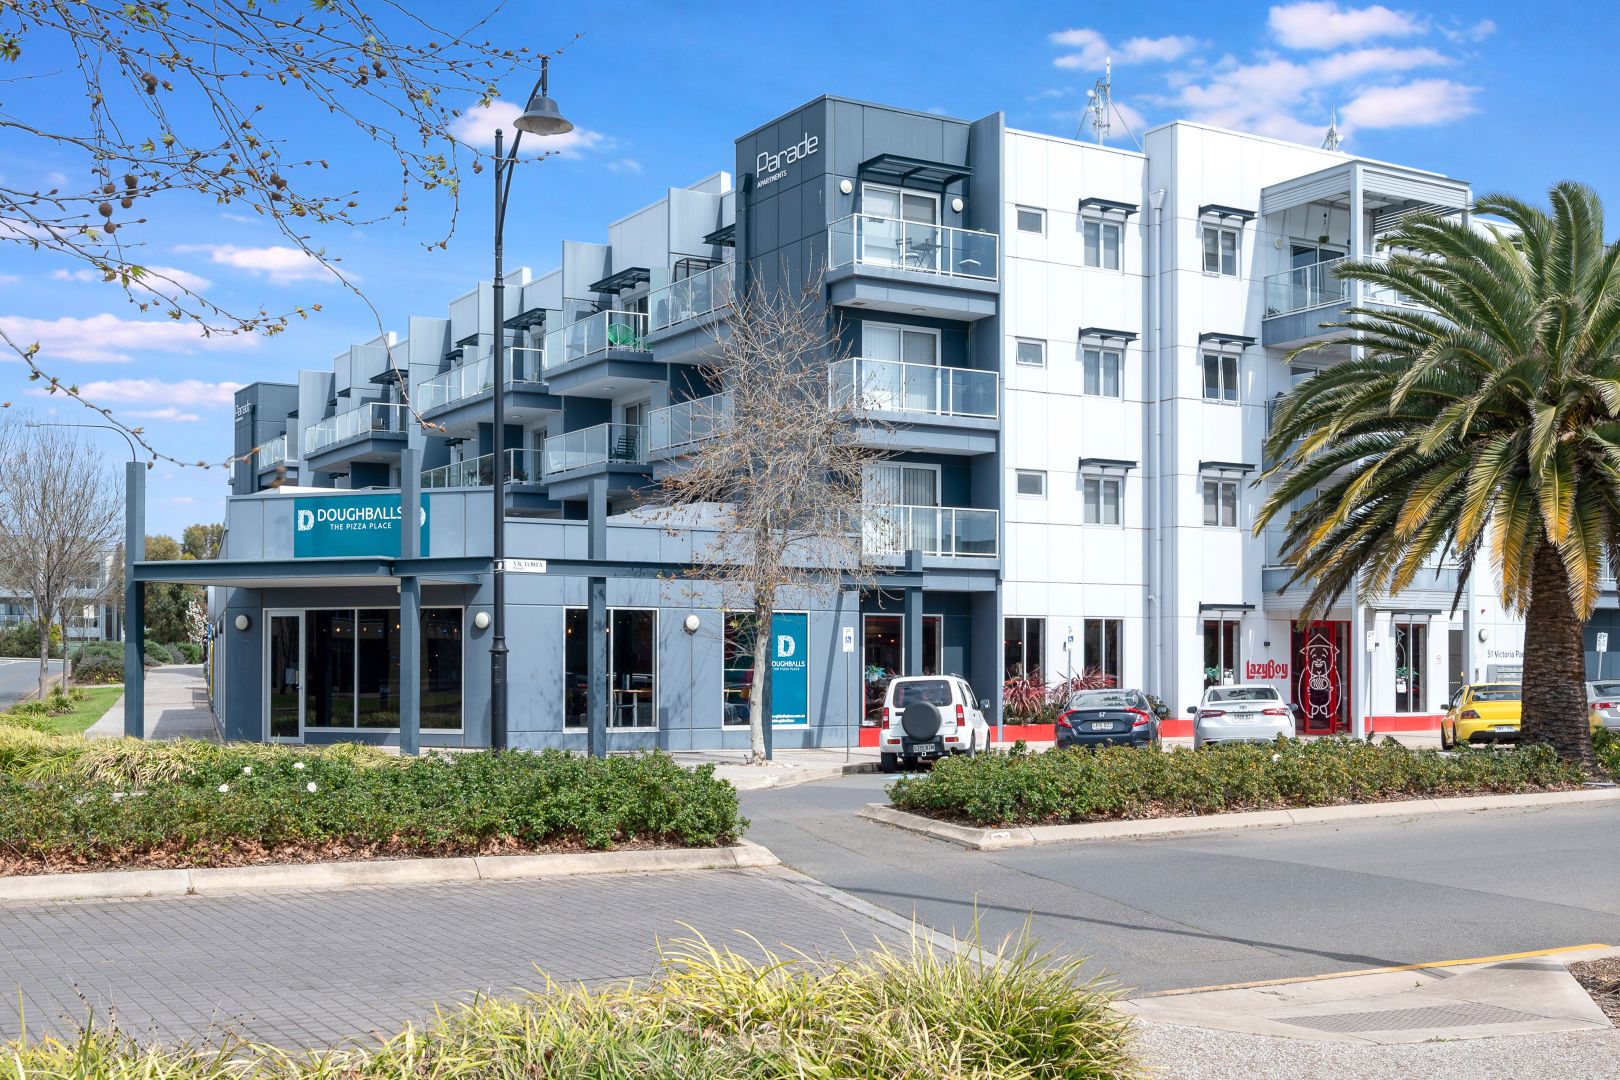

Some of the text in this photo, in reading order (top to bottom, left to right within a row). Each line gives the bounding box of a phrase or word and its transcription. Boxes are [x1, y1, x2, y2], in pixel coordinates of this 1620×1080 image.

[756, 132, 818, 178] Parade
[756, 169, 787, 188] APARTMENTS
[330, 523, 344, 531] THE
[369, 522, 392, 530] PLACE
[1494, 650, 1515, 658] Victoria
